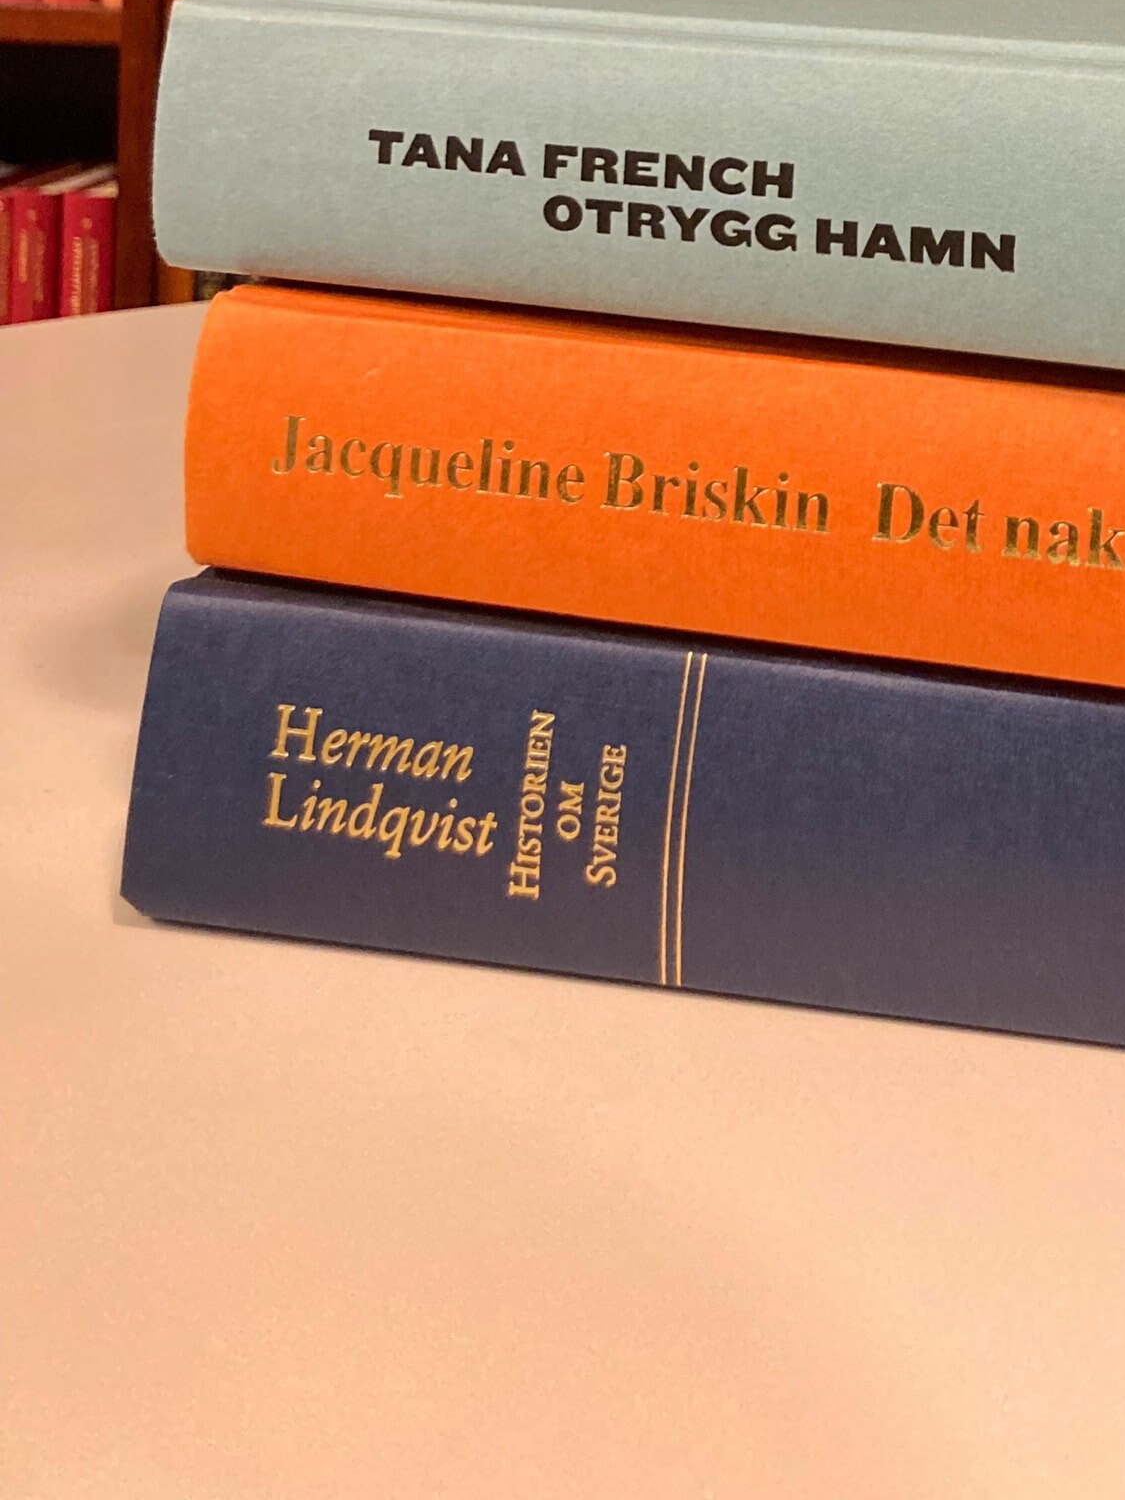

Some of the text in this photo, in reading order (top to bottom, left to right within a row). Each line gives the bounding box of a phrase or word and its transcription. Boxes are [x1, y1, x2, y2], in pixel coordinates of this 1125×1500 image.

[368, 129, 795, 198] TANA FRENCH
[543, 194, 1015, 272] OTRYGG HAMN
[270, 415, 830, 534] Jacqueline Briskin
[871, 481, 986, 554] Det
[271, 704, 475, 783] Herman
[263, 772, 498, 859] Lindqvist
[508, 709, 556, 900] HISTORIEN
[557, 781, 585, 841] OM
[585, 744, 628, 887] SVERIGE
